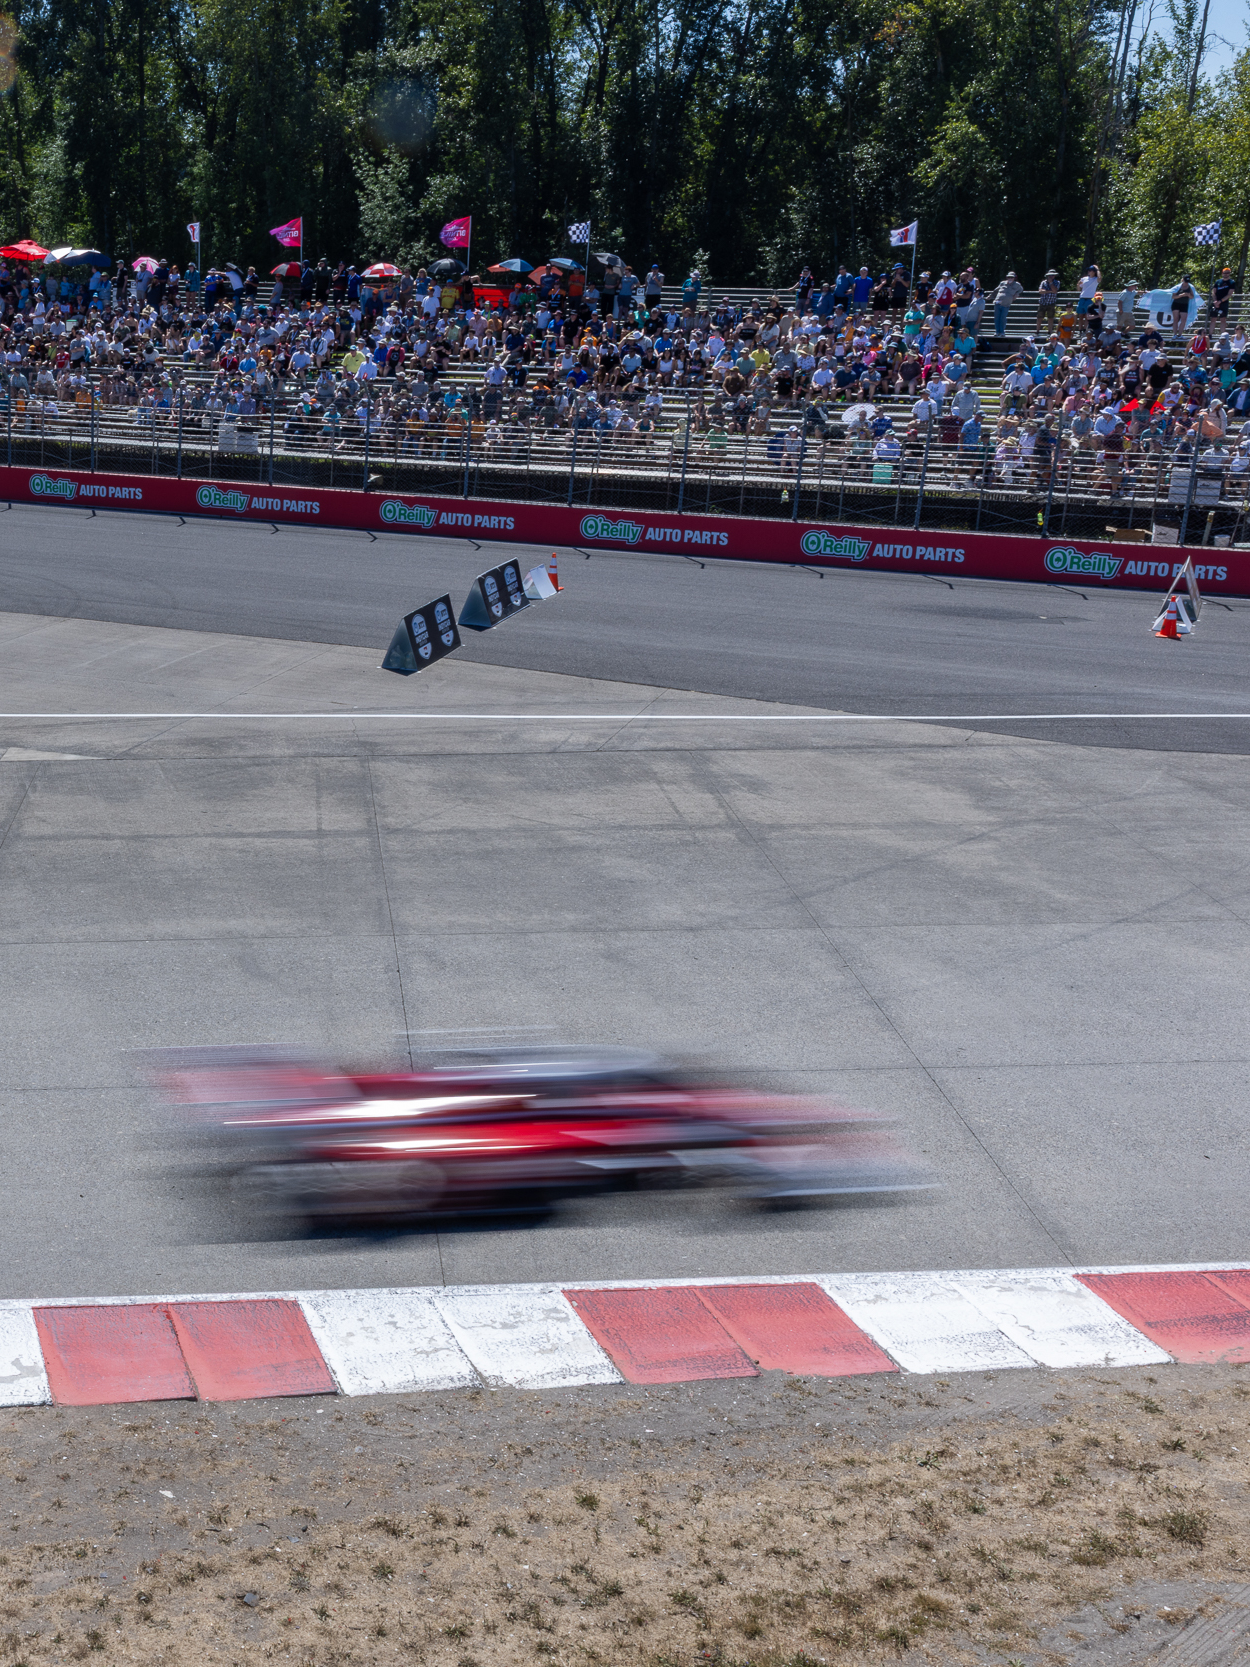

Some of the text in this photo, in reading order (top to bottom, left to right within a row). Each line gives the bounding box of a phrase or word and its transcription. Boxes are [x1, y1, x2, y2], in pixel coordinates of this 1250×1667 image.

[31, 476, 142, 499] O'Reilly AUTO PARTS
[199, 487, 319, 513] O'Reilly AUTO PARTS
[382, 502, 514, 529] O'Reilly AUTO PARTS
[582, 517, 728, 545] O'Reilly AUTO PARTS
[803, 532, 965, 562] O'Reilly AUTO PARTS
[1046, 548, 1228, 581] O'Reilly AUTO PRTS
